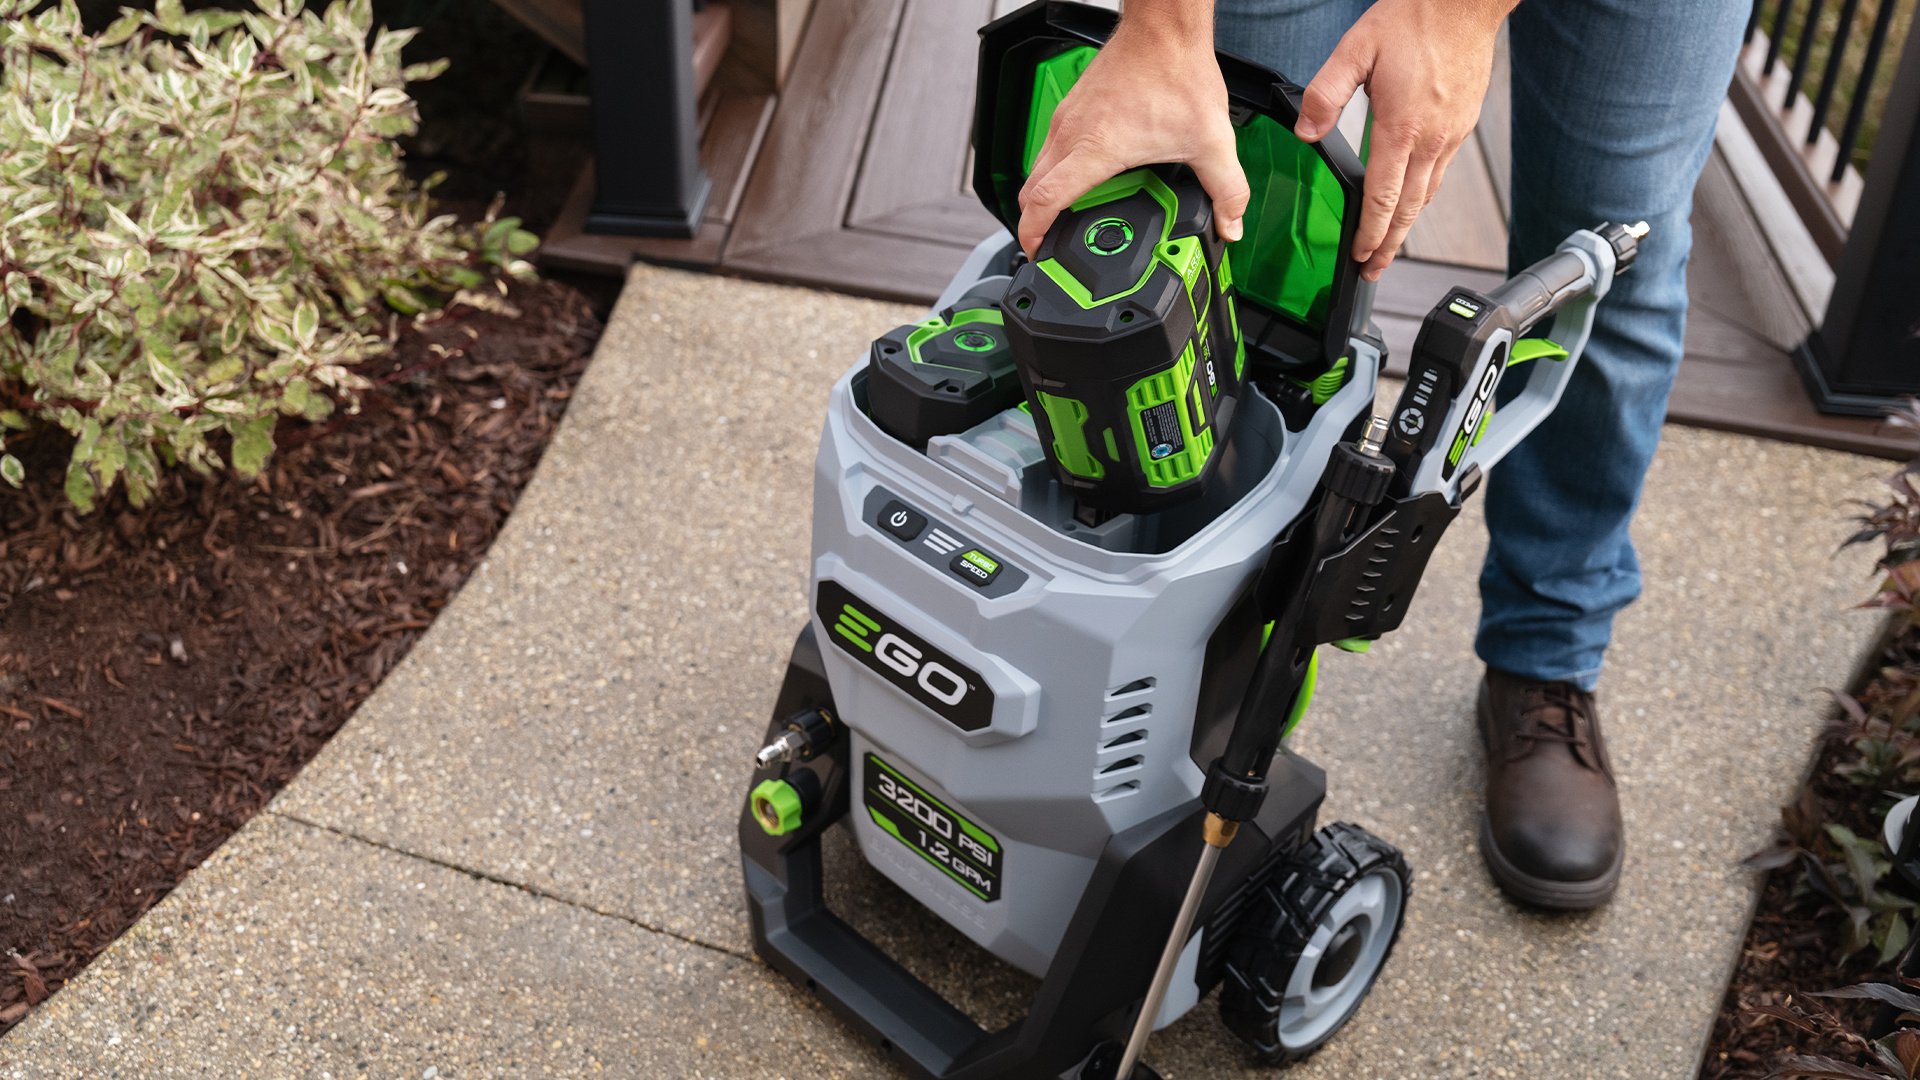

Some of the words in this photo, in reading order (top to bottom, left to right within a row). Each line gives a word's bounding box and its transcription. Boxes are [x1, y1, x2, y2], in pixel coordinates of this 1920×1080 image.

[1206, 361, 1218, 397] EGO
[1449, 363, 1498, 466] EGO
[960, 559, 988, 579] SPEED
[969, 552, 995, 571] TURBO
[834, 603, 968, 706] EGO
[878, 773, 952, 839] 3200
[958, 833, 992, 867] PSI
[918, 830, 950, 863] 1.2
[952, 857, 991, 892] GPM
